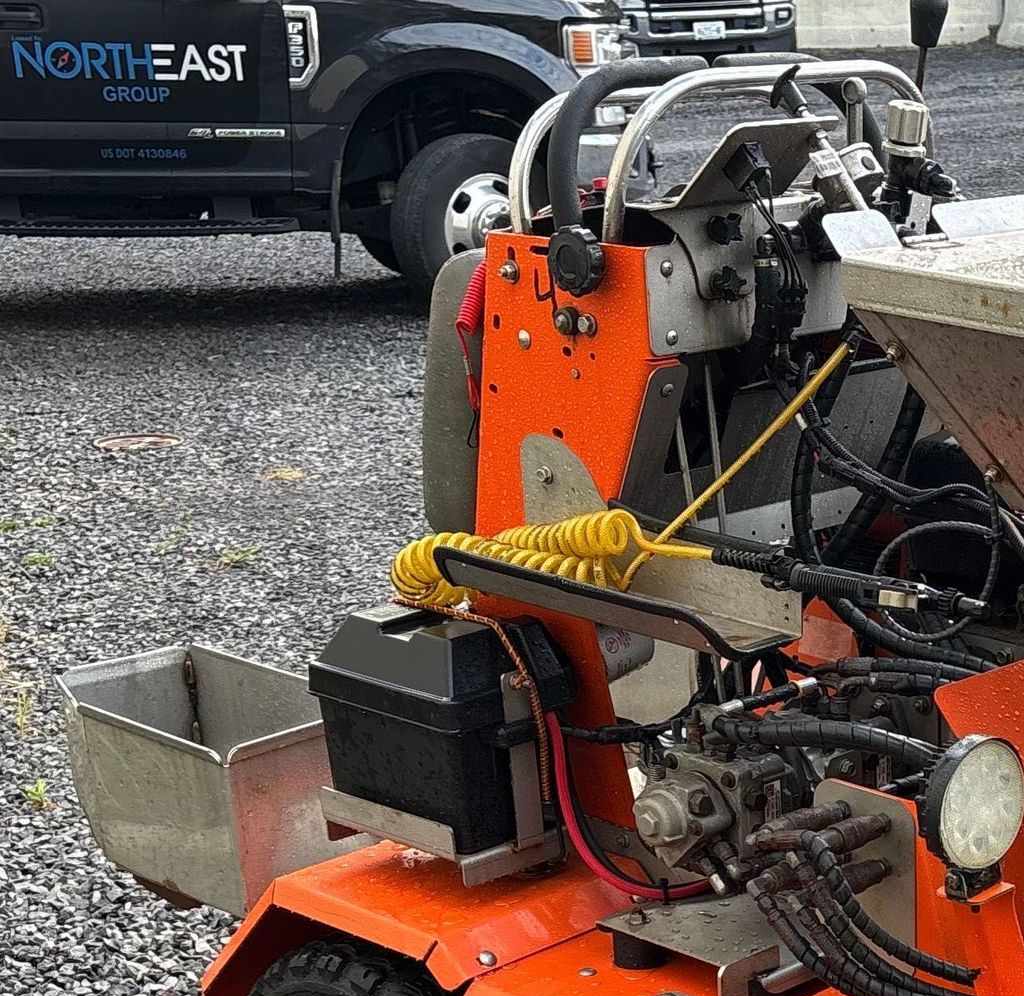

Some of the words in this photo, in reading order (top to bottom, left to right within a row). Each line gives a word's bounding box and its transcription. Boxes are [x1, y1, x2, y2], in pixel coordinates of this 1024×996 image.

[11, 41, 247, 82] NORTHEAST
[102, 86, 170, 103] GROUP
[101, 149, 113, 159] US
[116, 149, 135, 159] DOT
[138, 149, 187, 160] 4130846
